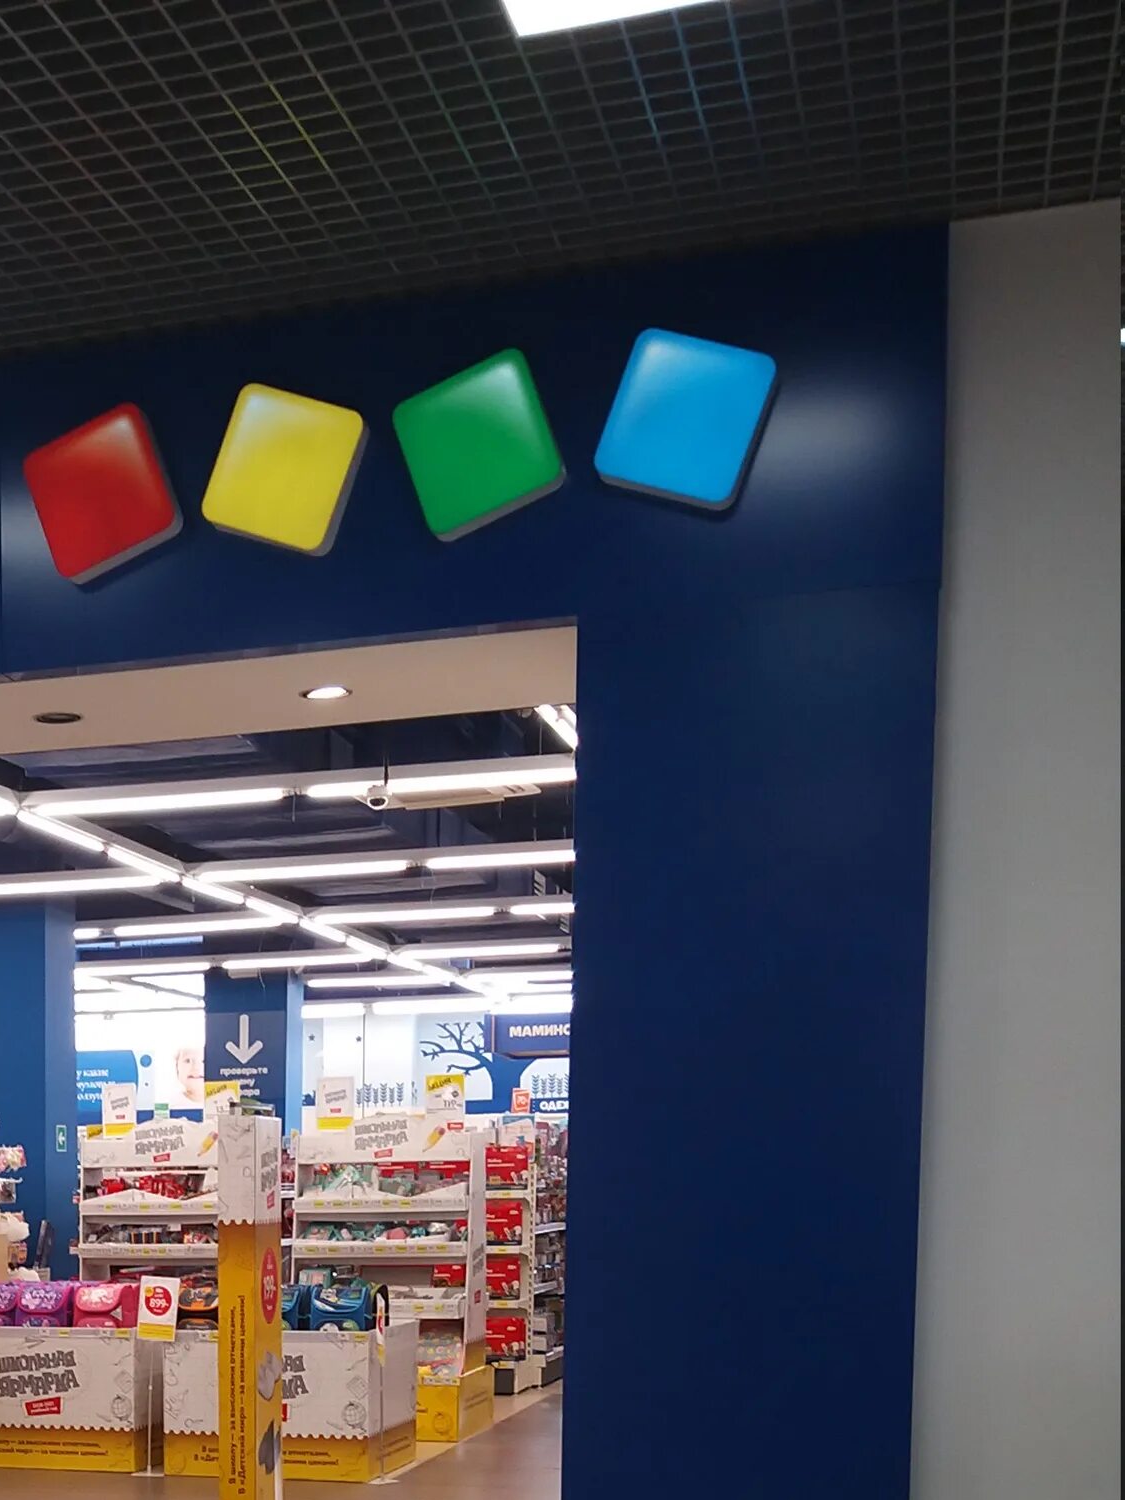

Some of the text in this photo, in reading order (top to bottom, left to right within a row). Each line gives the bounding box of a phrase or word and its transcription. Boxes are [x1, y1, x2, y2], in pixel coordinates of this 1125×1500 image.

[220, 1068, 268, 1077] проверьте
[239, 1386, 244, 1394] за
[230, 1420, 235, 1430] за
